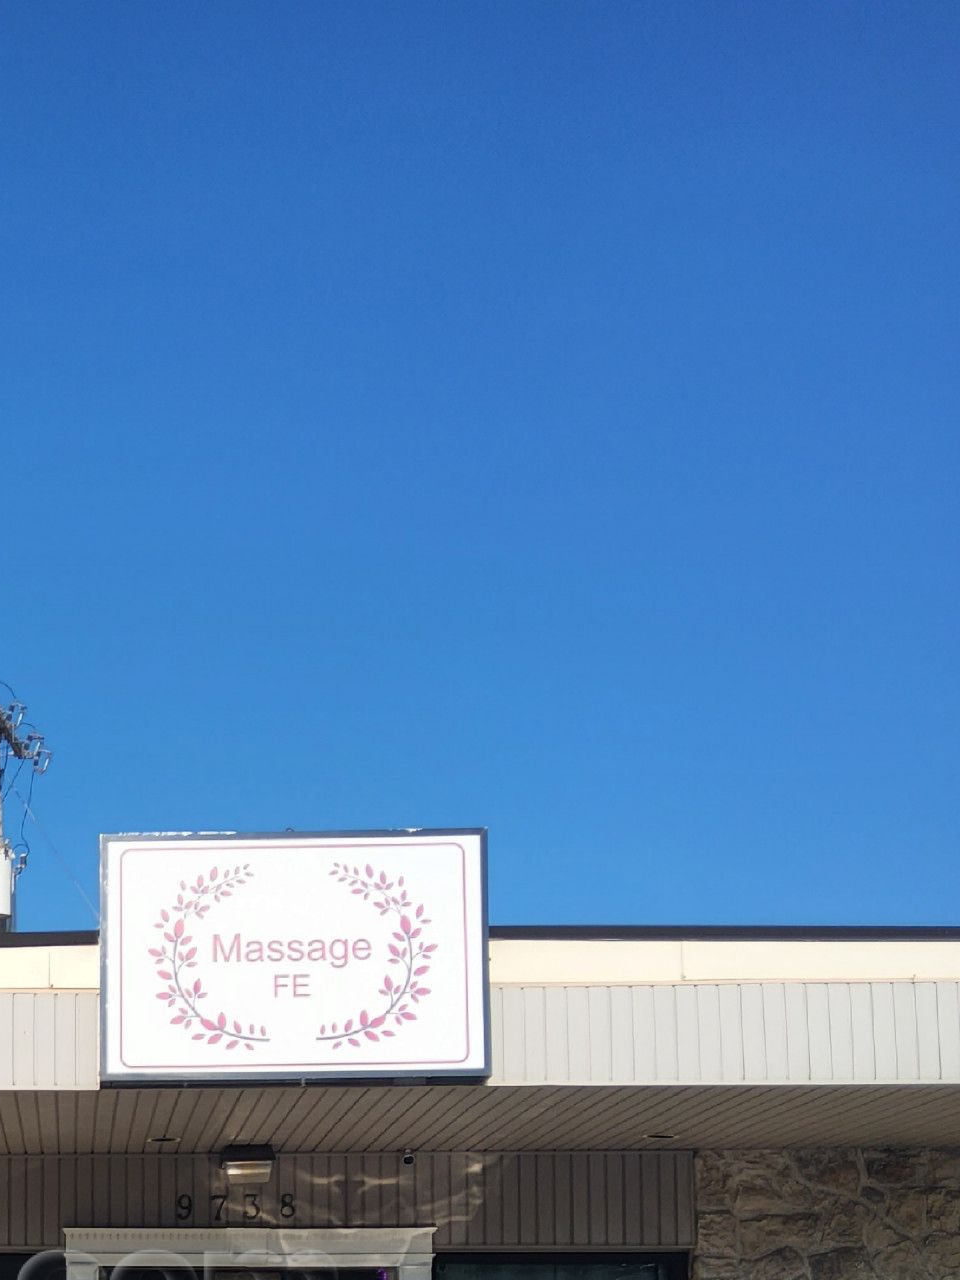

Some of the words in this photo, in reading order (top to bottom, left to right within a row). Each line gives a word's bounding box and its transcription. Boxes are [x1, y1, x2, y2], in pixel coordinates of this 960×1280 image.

[213, 933, 372, 968] Massage
[274, 974, 311, 998] FE
[177, 1193, 295, 1220] 9738
